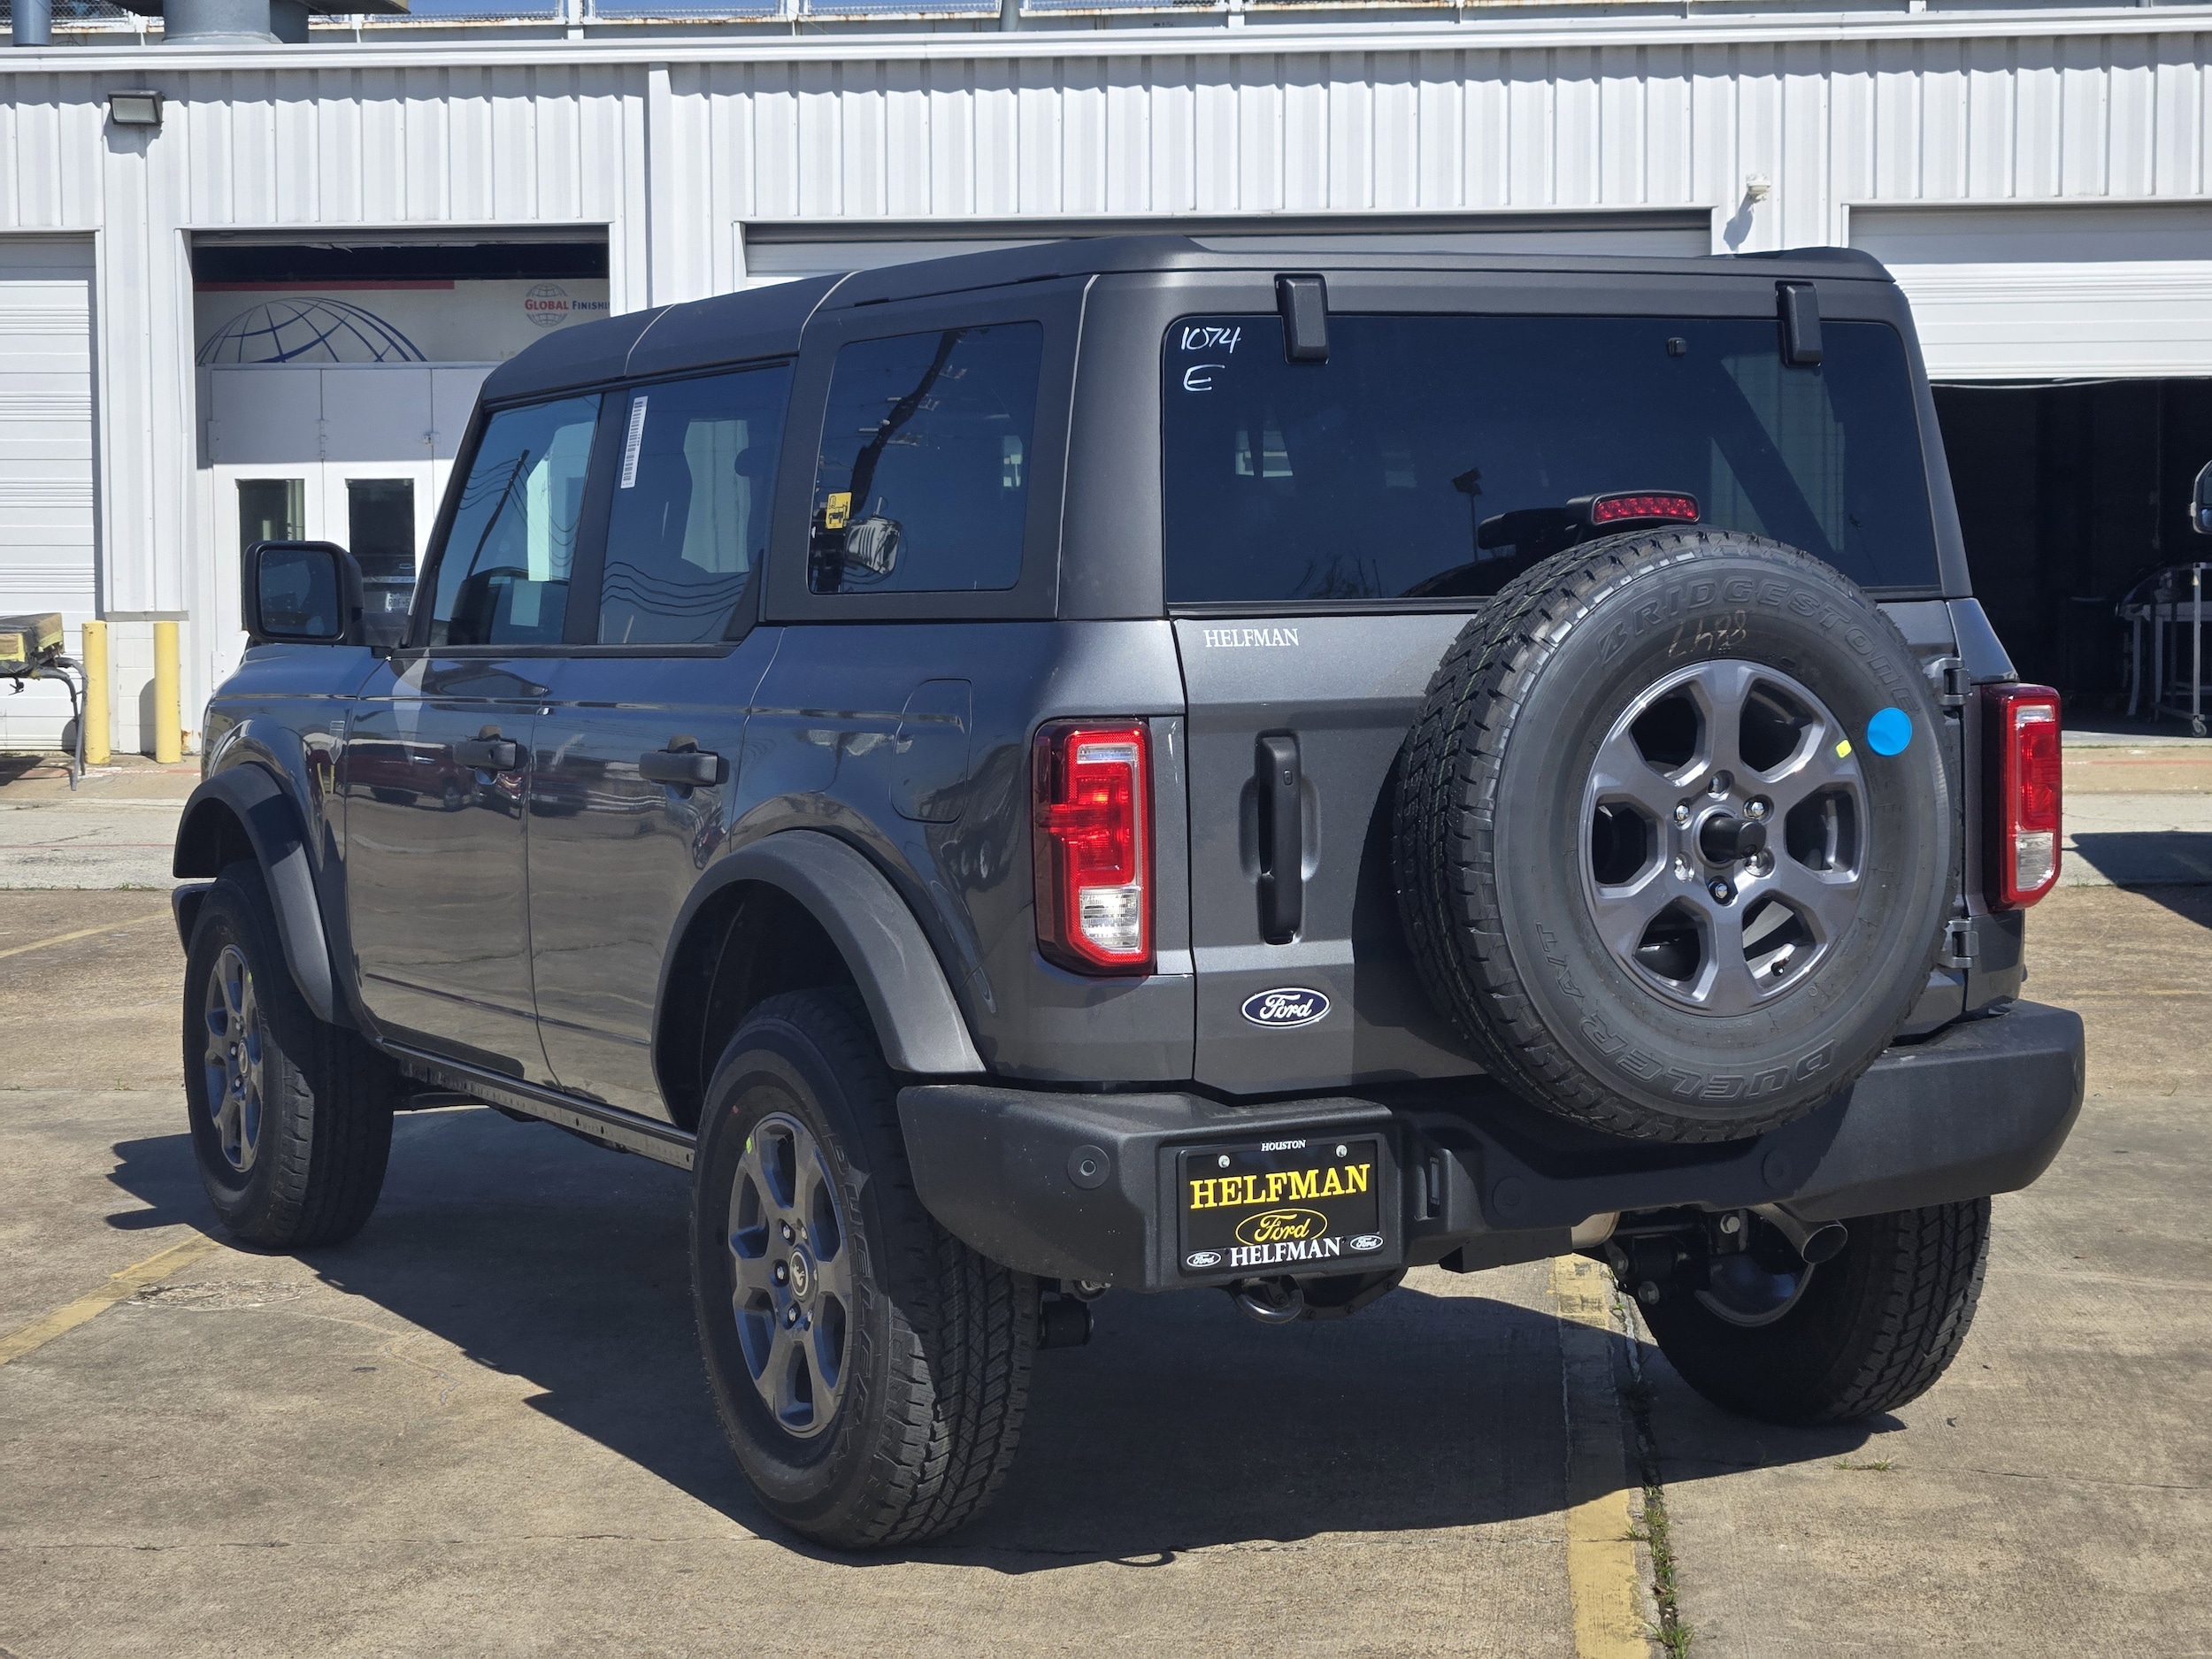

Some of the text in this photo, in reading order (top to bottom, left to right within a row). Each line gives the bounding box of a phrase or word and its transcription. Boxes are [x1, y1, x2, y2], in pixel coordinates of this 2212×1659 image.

[525, 299, 569, 311] GLOBAL
[1180, 326, 1242, 354] 1074
[1183, 364, 1226, 392] E
[1202, 627, 1300, 648] HELFMAN
[1596, 575, 1922, 717] BRIDGESTONE
[1259, 994, 1315, 1019] Ford
[1578, 1011, 1838, 1102] DUELER
[1260, 1139, 1307, 1151] HOUSTON
[1189, 1163, 1371, 1210] HELFMAN
[1253, 1213, 1311, 1242] Ford
[1192, 1236, 1379, 1267] Ford HELFMAN Ford
